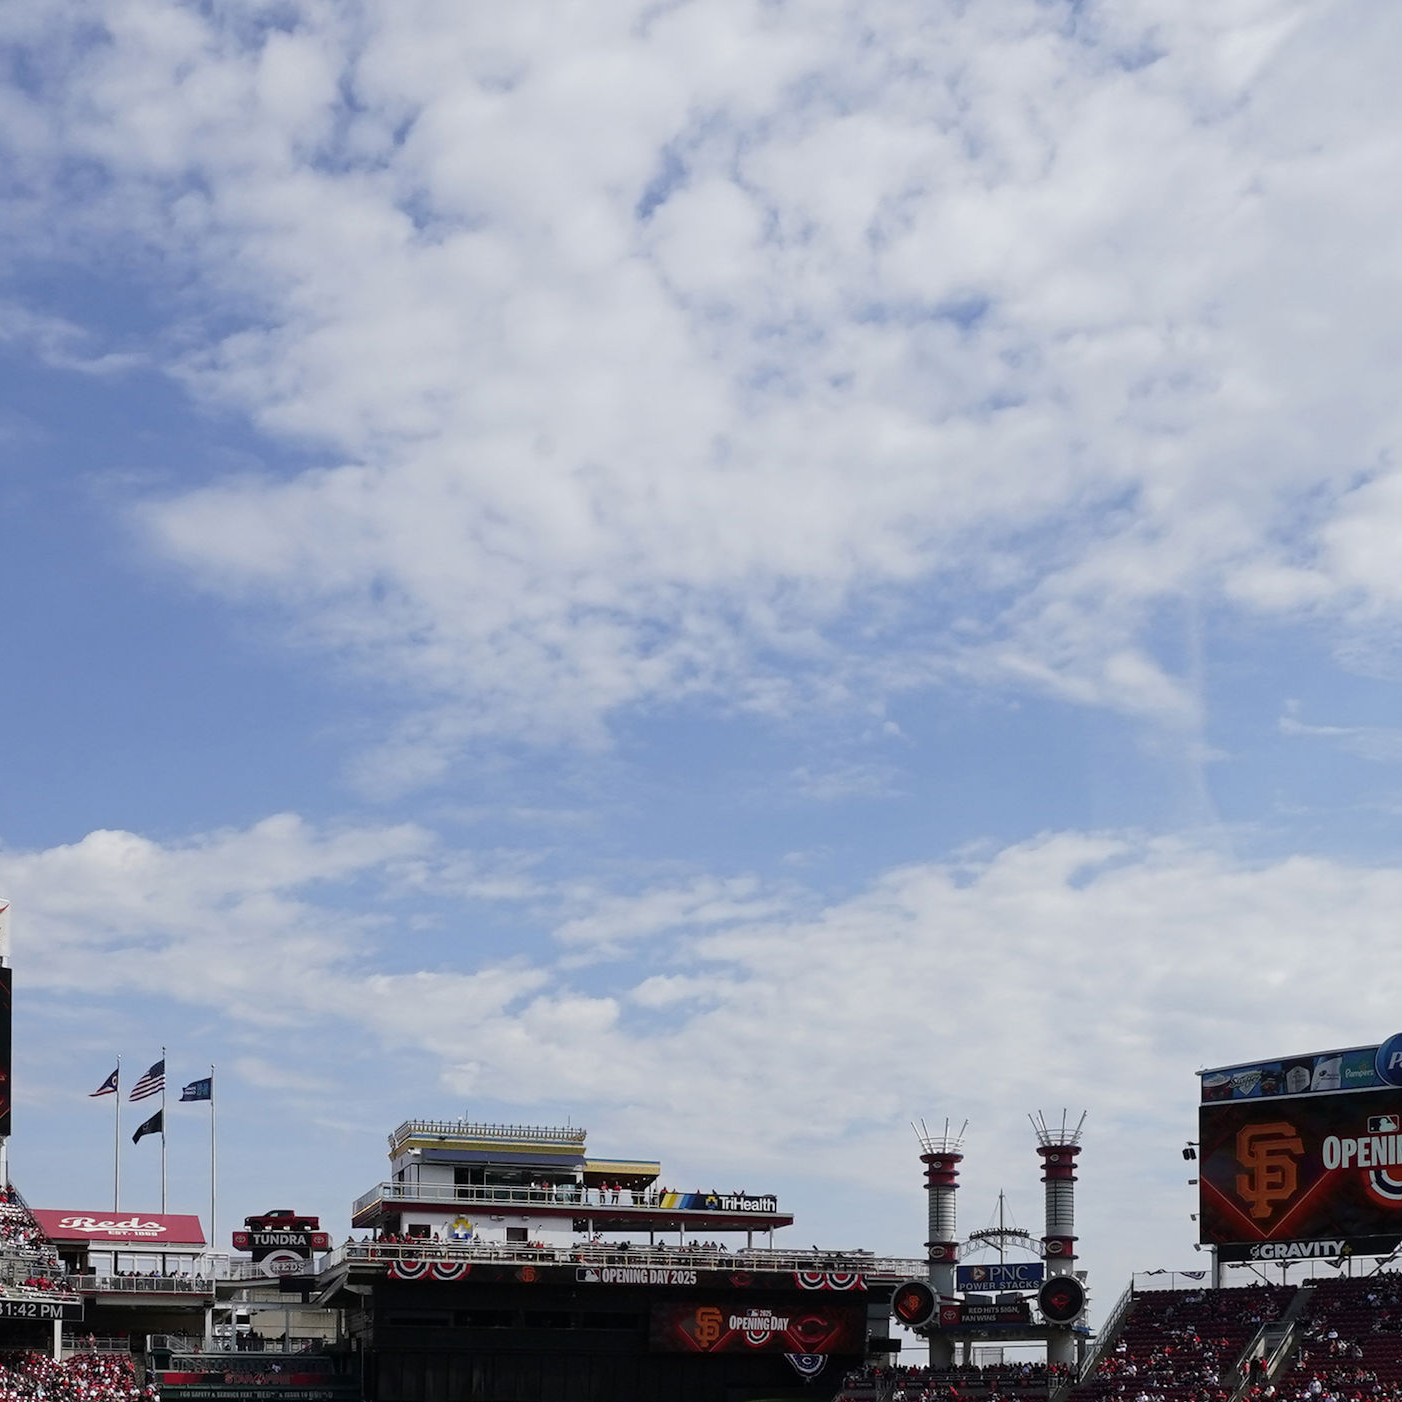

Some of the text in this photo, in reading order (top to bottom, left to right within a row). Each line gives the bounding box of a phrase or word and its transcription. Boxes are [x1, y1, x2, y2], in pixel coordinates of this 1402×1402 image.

[718, 1196, 775, 1211] TriHealth
[58, 1217, 167, 1233] Reds
[253, 1234, 307, 1245] TUNDRA
[601, 1268, 697, 1285] OPENING DAY 2025
[989, 1265, 1029, 1281] PNC
[959, 1280, 1040, 1291] POWER STACKS
[41, 1304, 63, 1318] PM
[729, 1315, 790, 1331] OPENING DAY
